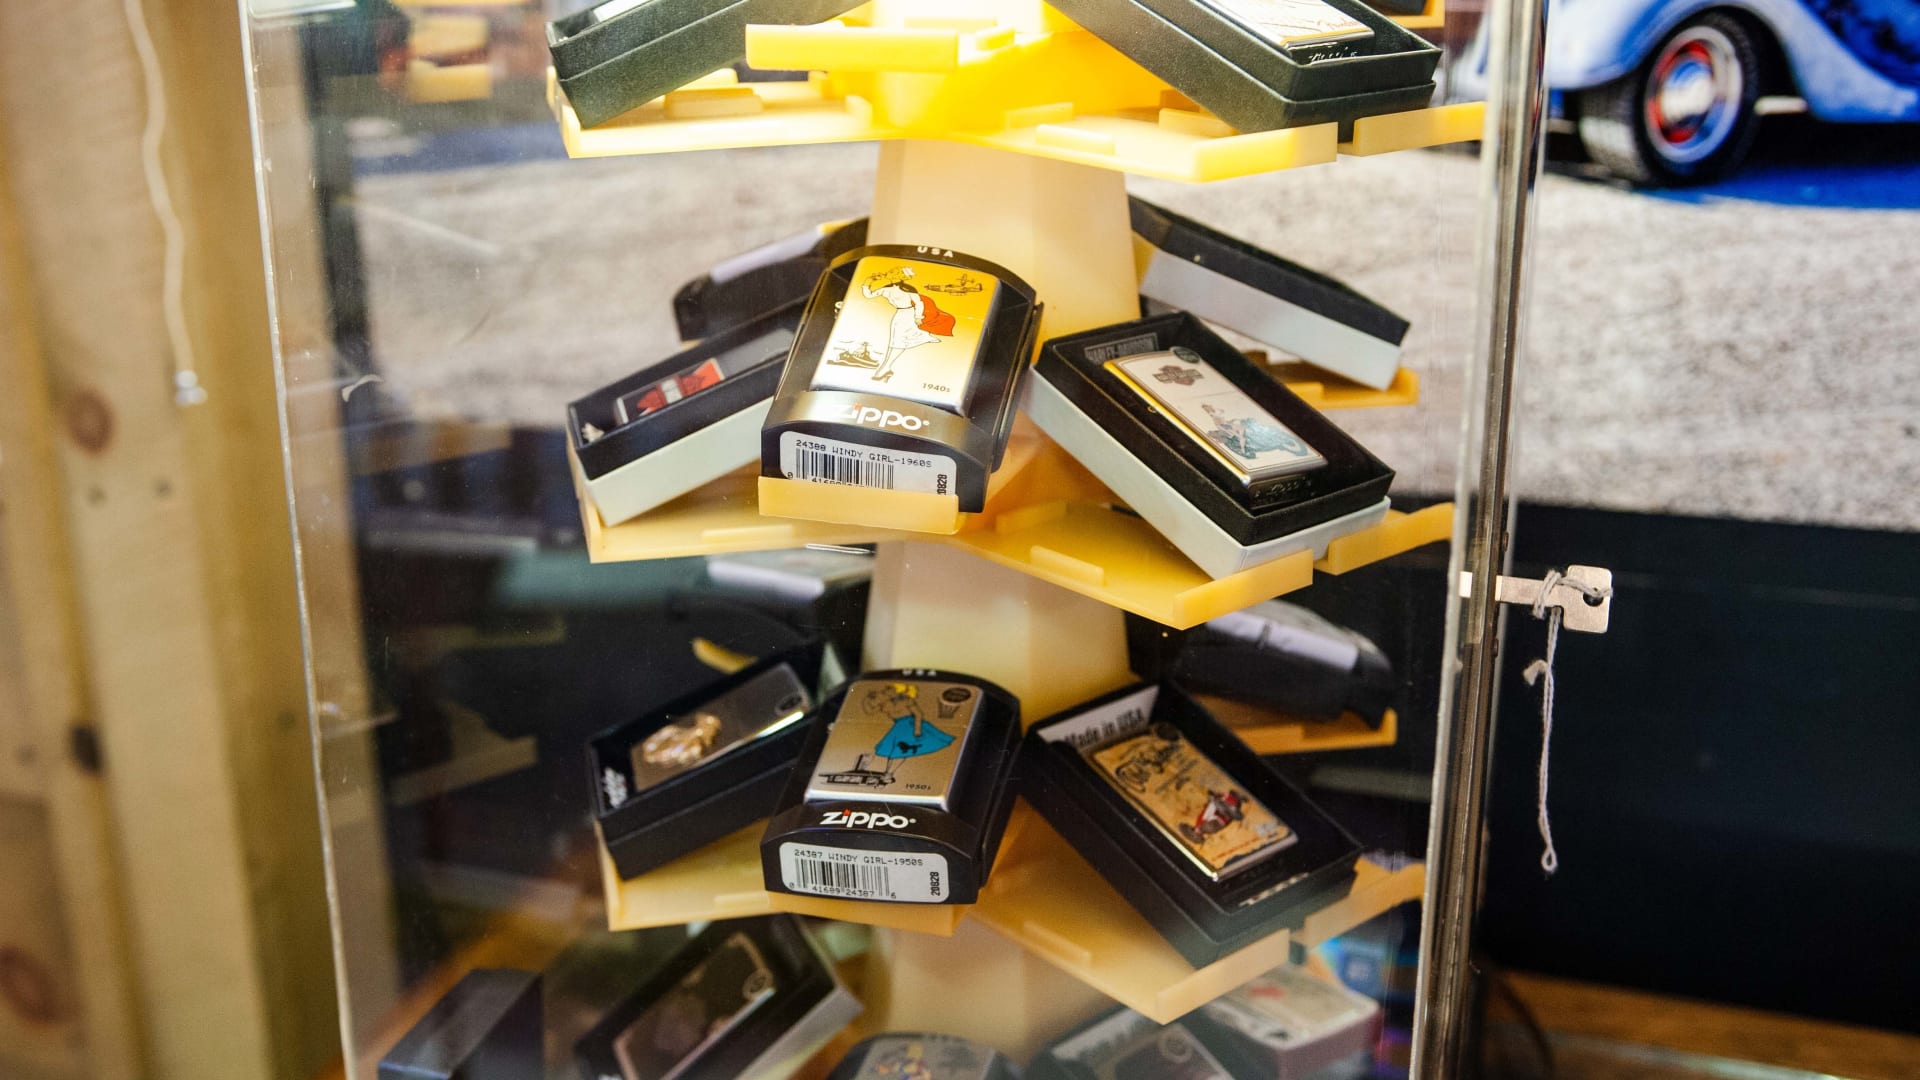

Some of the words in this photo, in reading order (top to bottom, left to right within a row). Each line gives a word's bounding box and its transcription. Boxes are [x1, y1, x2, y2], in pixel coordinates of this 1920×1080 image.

[917, 246, 953, 258] USA
[922, 383, 950, 393] 1940s
[832, 446, 863, 457] WINDY
[869, 453, 932, 468] GIRL-1960S
[937, 474, 947, 495] 0828
[794, 849, 822, 858] 24387
[828, 853, 857, 862] WINDY
[863, 856, 924, 867] GIRL-1950S
